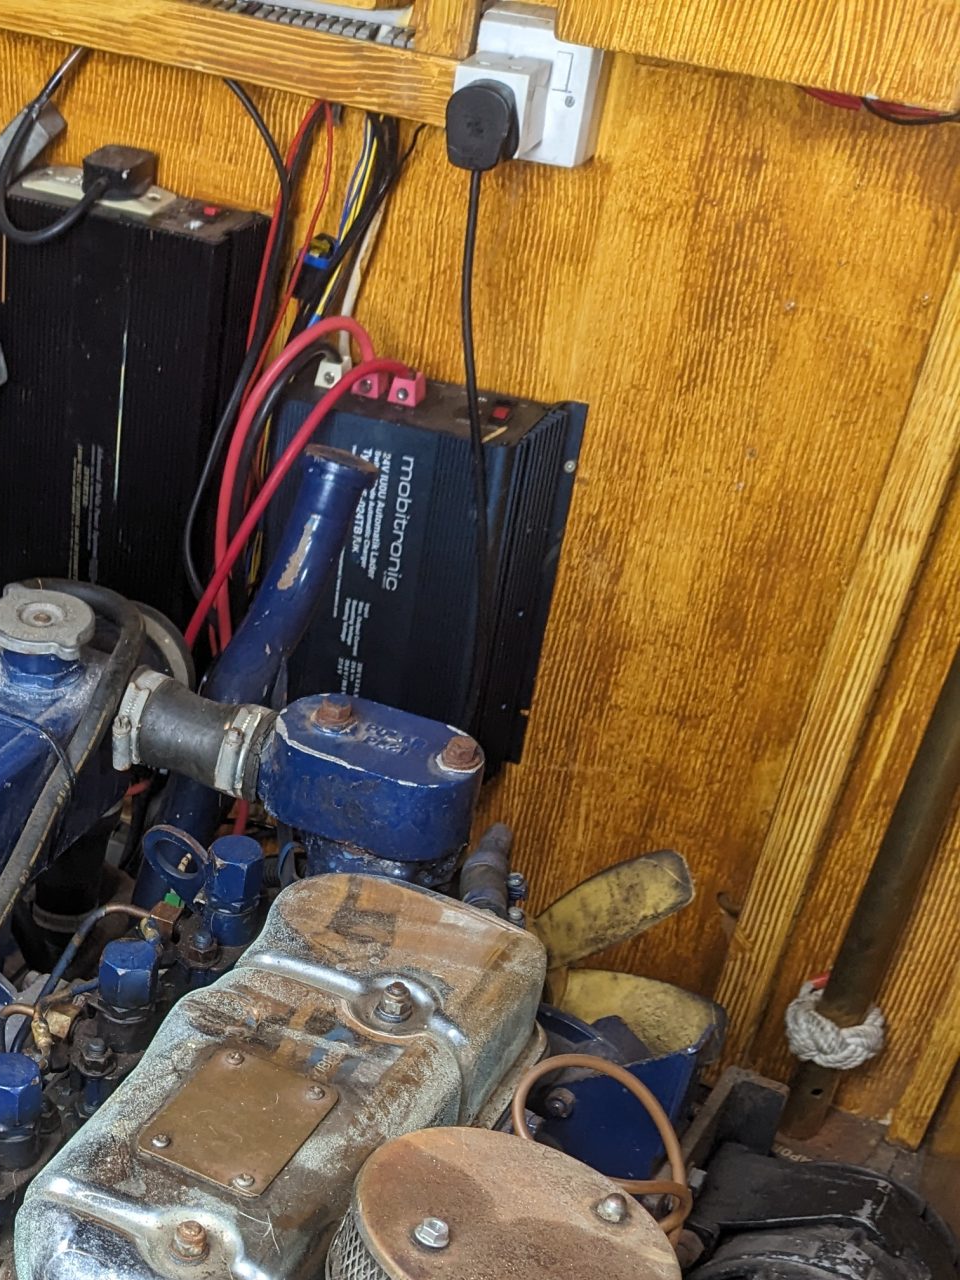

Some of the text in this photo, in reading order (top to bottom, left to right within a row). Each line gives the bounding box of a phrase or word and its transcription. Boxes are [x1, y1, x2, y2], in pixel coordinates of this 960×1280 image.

[380, 451, 392, 473] 24V
[370, 500, 385, 549] Automatik
[385, 454, 415, 592] mobitronic
[366, 550, 378, 580] Lader
